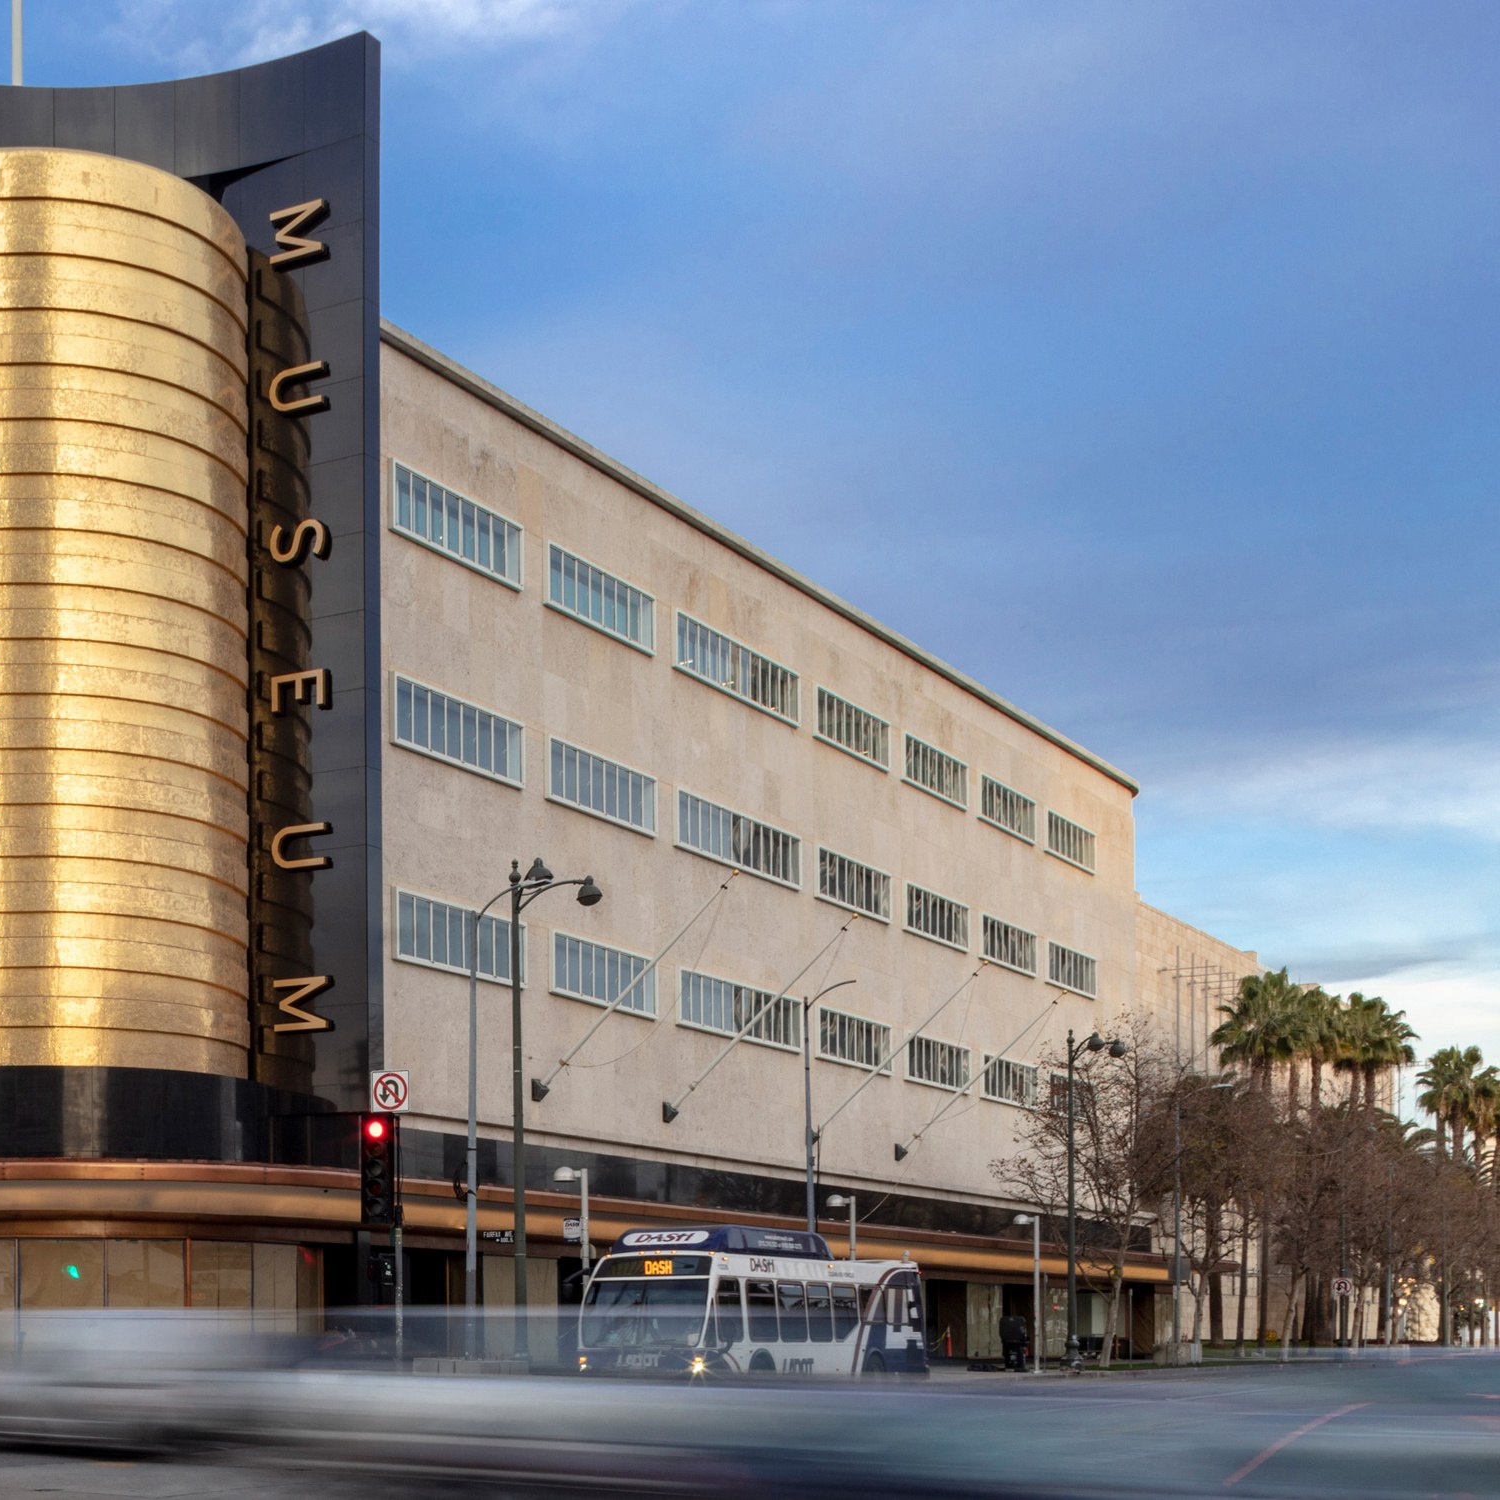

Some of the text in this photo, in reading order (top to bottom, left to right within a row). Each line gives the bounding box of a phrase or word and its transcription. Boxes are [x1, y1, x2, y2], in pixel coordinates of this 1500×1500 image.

[269, 197, 335, 1034] MUSEUM
[635, 1232, 695, 1243] DASH
[644, 1260, 673, 1275] DASH
[750, 1258, 775, 1273] DASH
